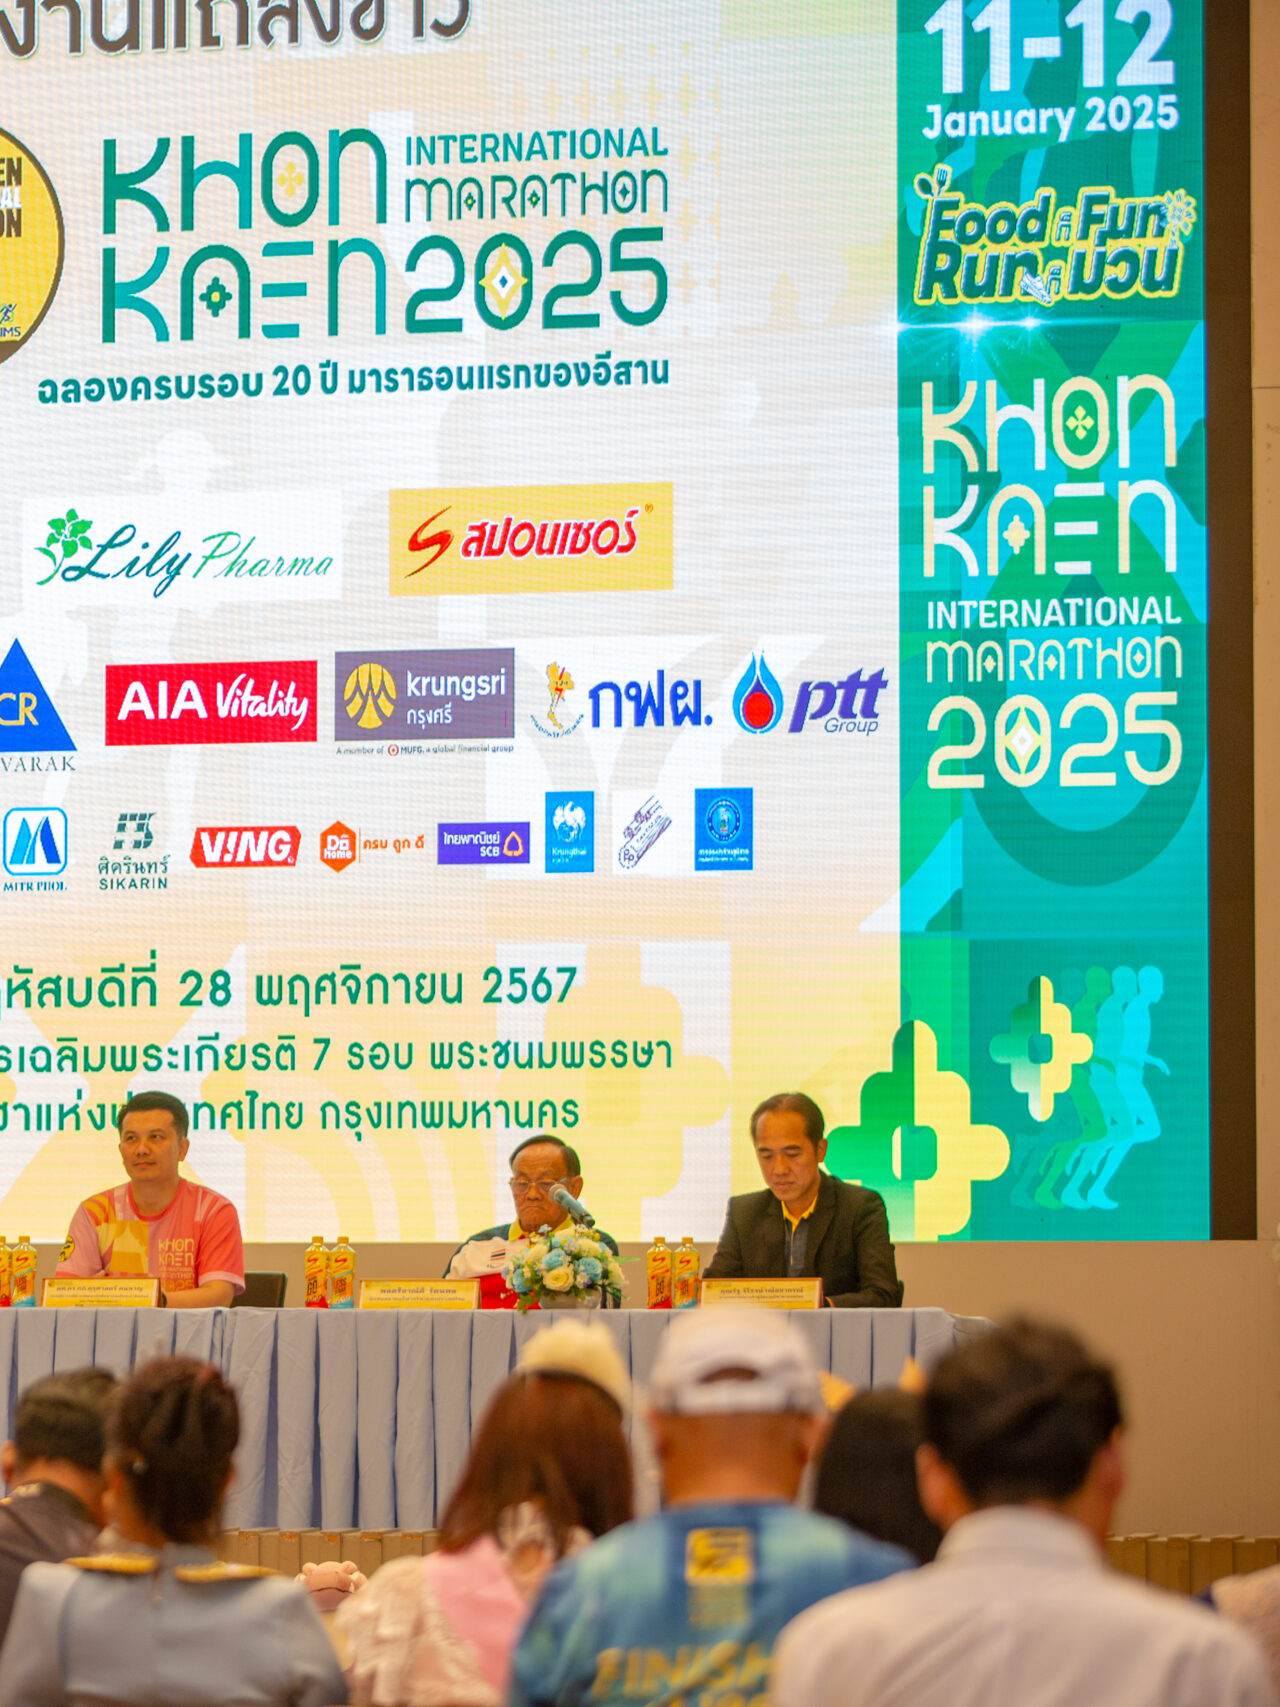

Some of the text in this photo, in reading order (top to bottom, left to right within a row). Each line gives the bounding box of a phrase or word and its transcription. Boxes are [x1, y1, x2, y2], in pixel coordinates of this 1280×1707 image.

[923, 0, 1176, 94] 11-12
[922, 94, 1180, 143] January 2025
[406, 126, 670, 166] INTERNATIONAL
[102, 128, 387, 234] KHON
[405, 169, 670, 223] MARATHON
[928, 193, 1052, 248] Food
[1076, 190, 1168, 242] Fun
[102, 238, 387, 343] KAEN
[405, 226, 669, 334] 2025
[918, 239, 1039, 300] Run
[37, 350, 670, 404] ฉลองครบรอบ 20 ปี มาราธอนแรกของอีสาน
[922, 373, 1177, 474] KHON
[460, 508, 640, 558] สปอนเซอร์
[922, 479, 1177, 578] KAEN
[61, 524, 334, 598] Lily Pharma
[927, 596, 1182, 629] INTERNATIONAL
[407, 668, 506, 701] krungsri
[926, 635, 1182, 683] MARATHON
[117, 673, 309, 731] AIA Vitality
[406, 702, 453, 729] กรุงศรี
[588, 669, 713, 728] กฟผ.
[788, 667, 889, 733] ptt
[824, 717, 879, 737] Group
[927, 691, 1182, 789] 2025
[324, 848, 352, 859] home
[363, 838, 388, 850] ครบ
[415, 834, 425, 849] ดี
[480, 846, 500, 858] SCB
[98, 878, 169, 891] SIKARIN
[179, 970, 231, 1006] 28
[255, 963, 463, 1017] พฤศจิกายน
[482, 966, 578, 1004] 2567
[312, 1037, 331, 1071] 7
[347, 1039, 413, 1071] รอบ
[431, 1038, 673, 1070] พระชนมพรรษา
[320, 1099, 579, 1142] กรุงเทพมหานคร
